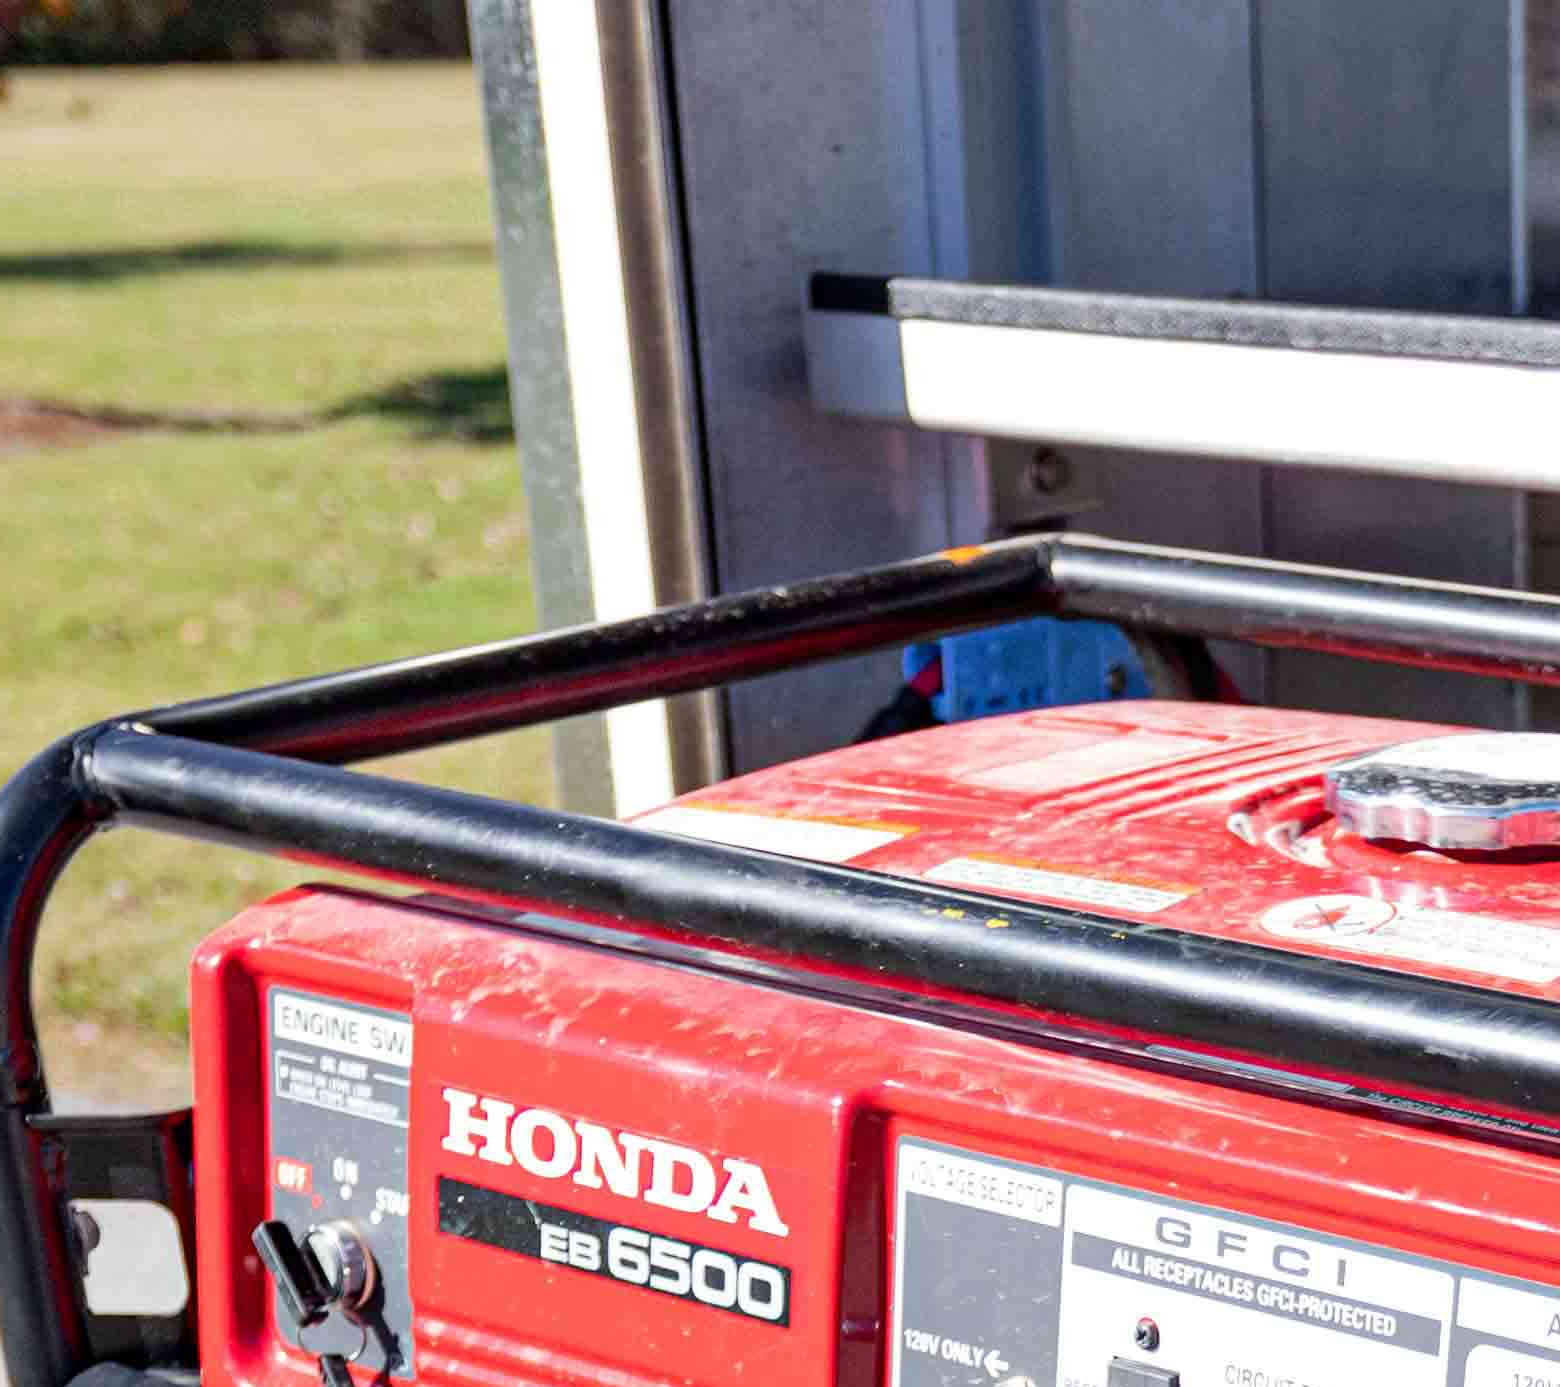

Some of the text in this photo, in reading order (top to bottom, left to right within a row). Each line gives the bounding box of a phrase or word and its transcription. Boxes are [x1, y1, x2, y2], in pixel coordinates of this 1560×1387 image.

[281, 1006, 407, 1055] ENGINE SW
[333, 1156, 359, 1186] ON
[441, 1087, 790, 1237] HONDA
[539, 1222, 786, 1321] EB 6500
[1155, 1216, 1347, 1287] GFCI
[1111, 1247, 1397, 1338] ALL RECEPTACLES GFCI-PROTECTED
[903, 1328, 985, 1369] 120V ONLY
